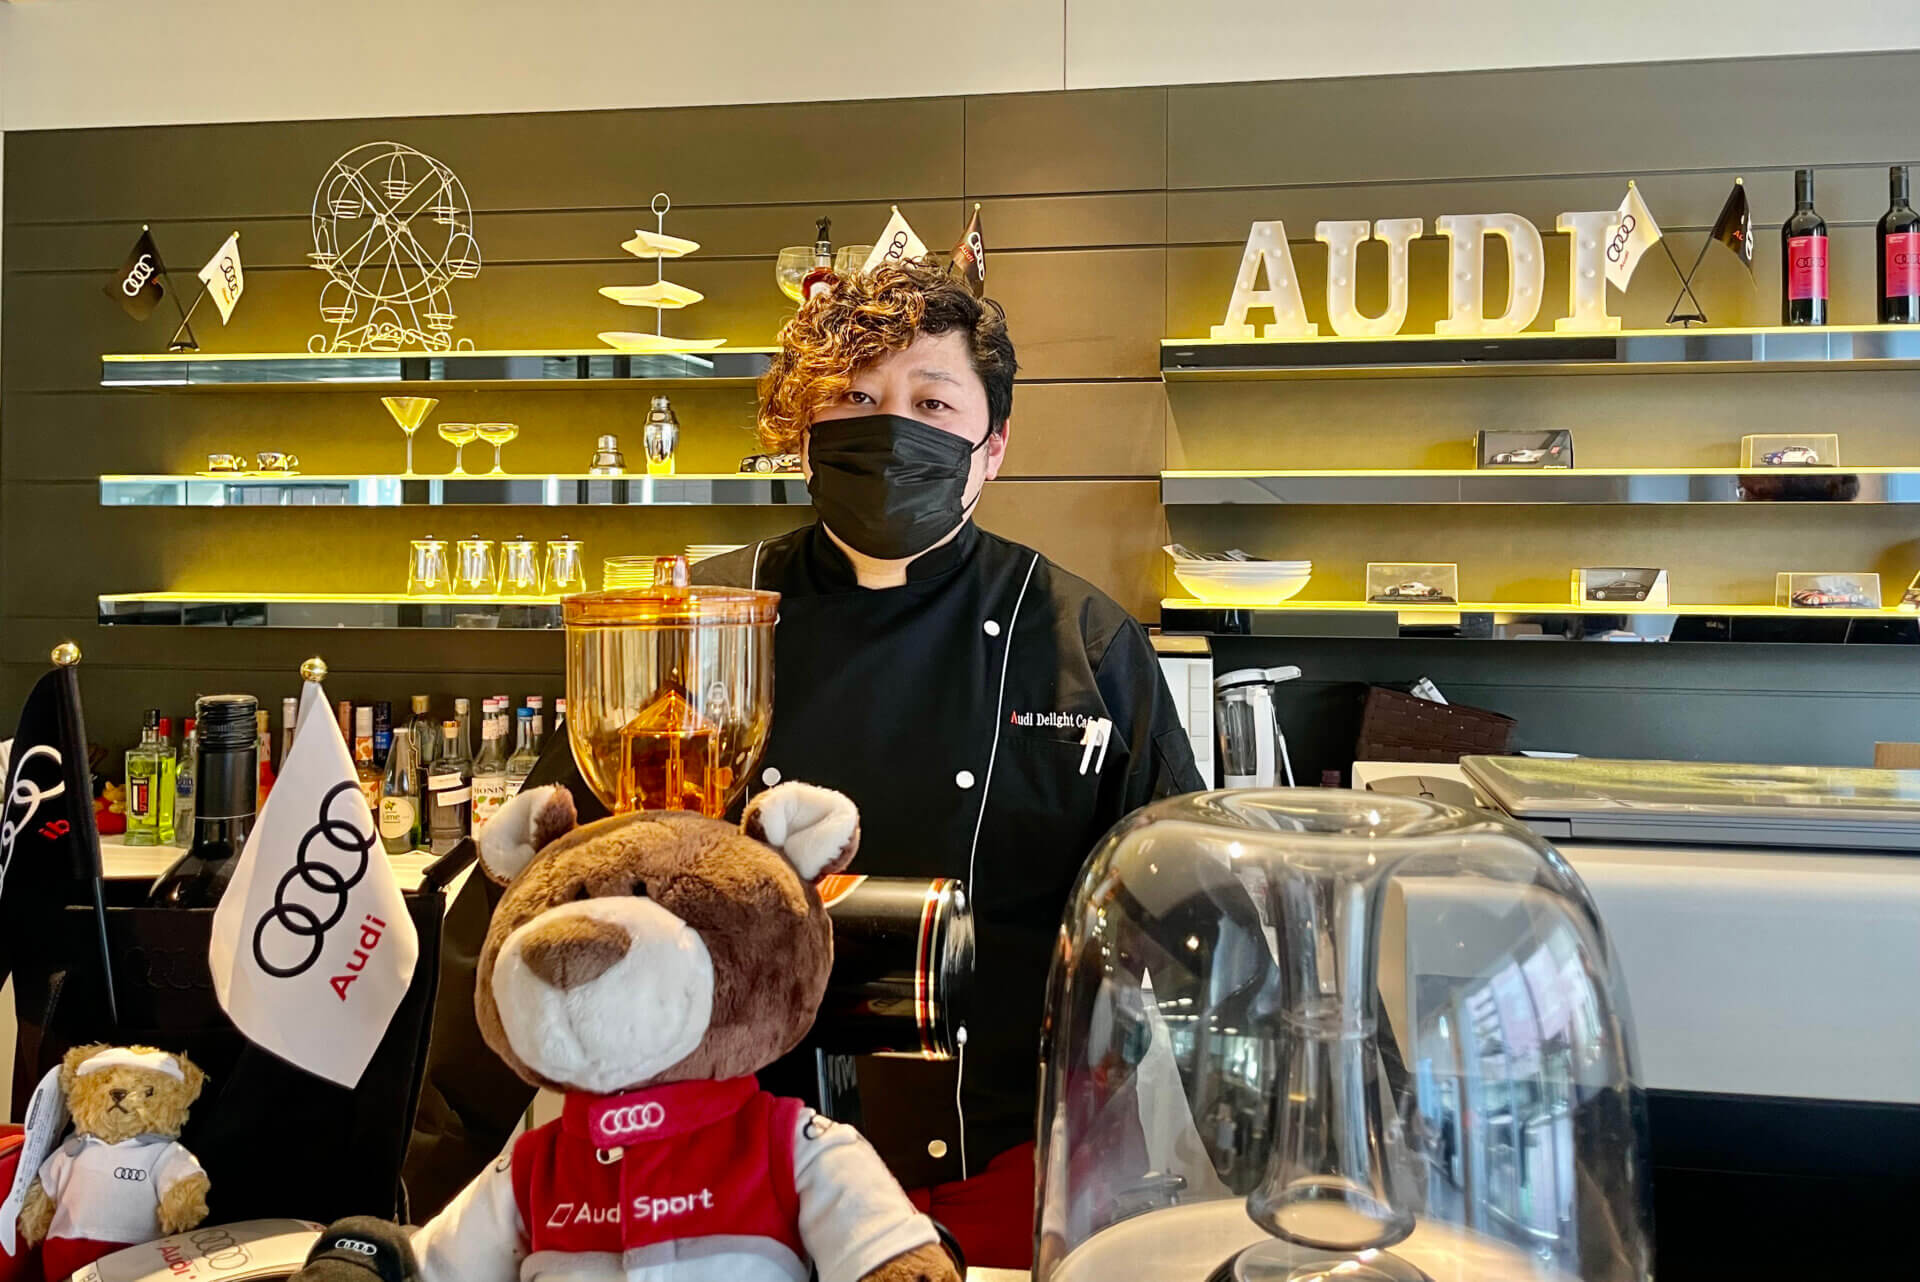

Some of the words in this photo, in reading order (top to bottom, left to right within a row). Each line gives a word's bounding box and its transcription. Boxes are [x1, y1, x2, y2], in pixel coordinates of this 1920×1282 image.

[1210, 210, 1622, 338] AUDI
[1010, 709, 1033, 727] Audi
[1036, 712, 1075, 728] Delight
[329, 914, 387, 1001] Audi
[574, 1202, 621, 1224] Aud
[633, 1187, 714, 1223] Sport
[159, 1244, 193, 1275] Audi
